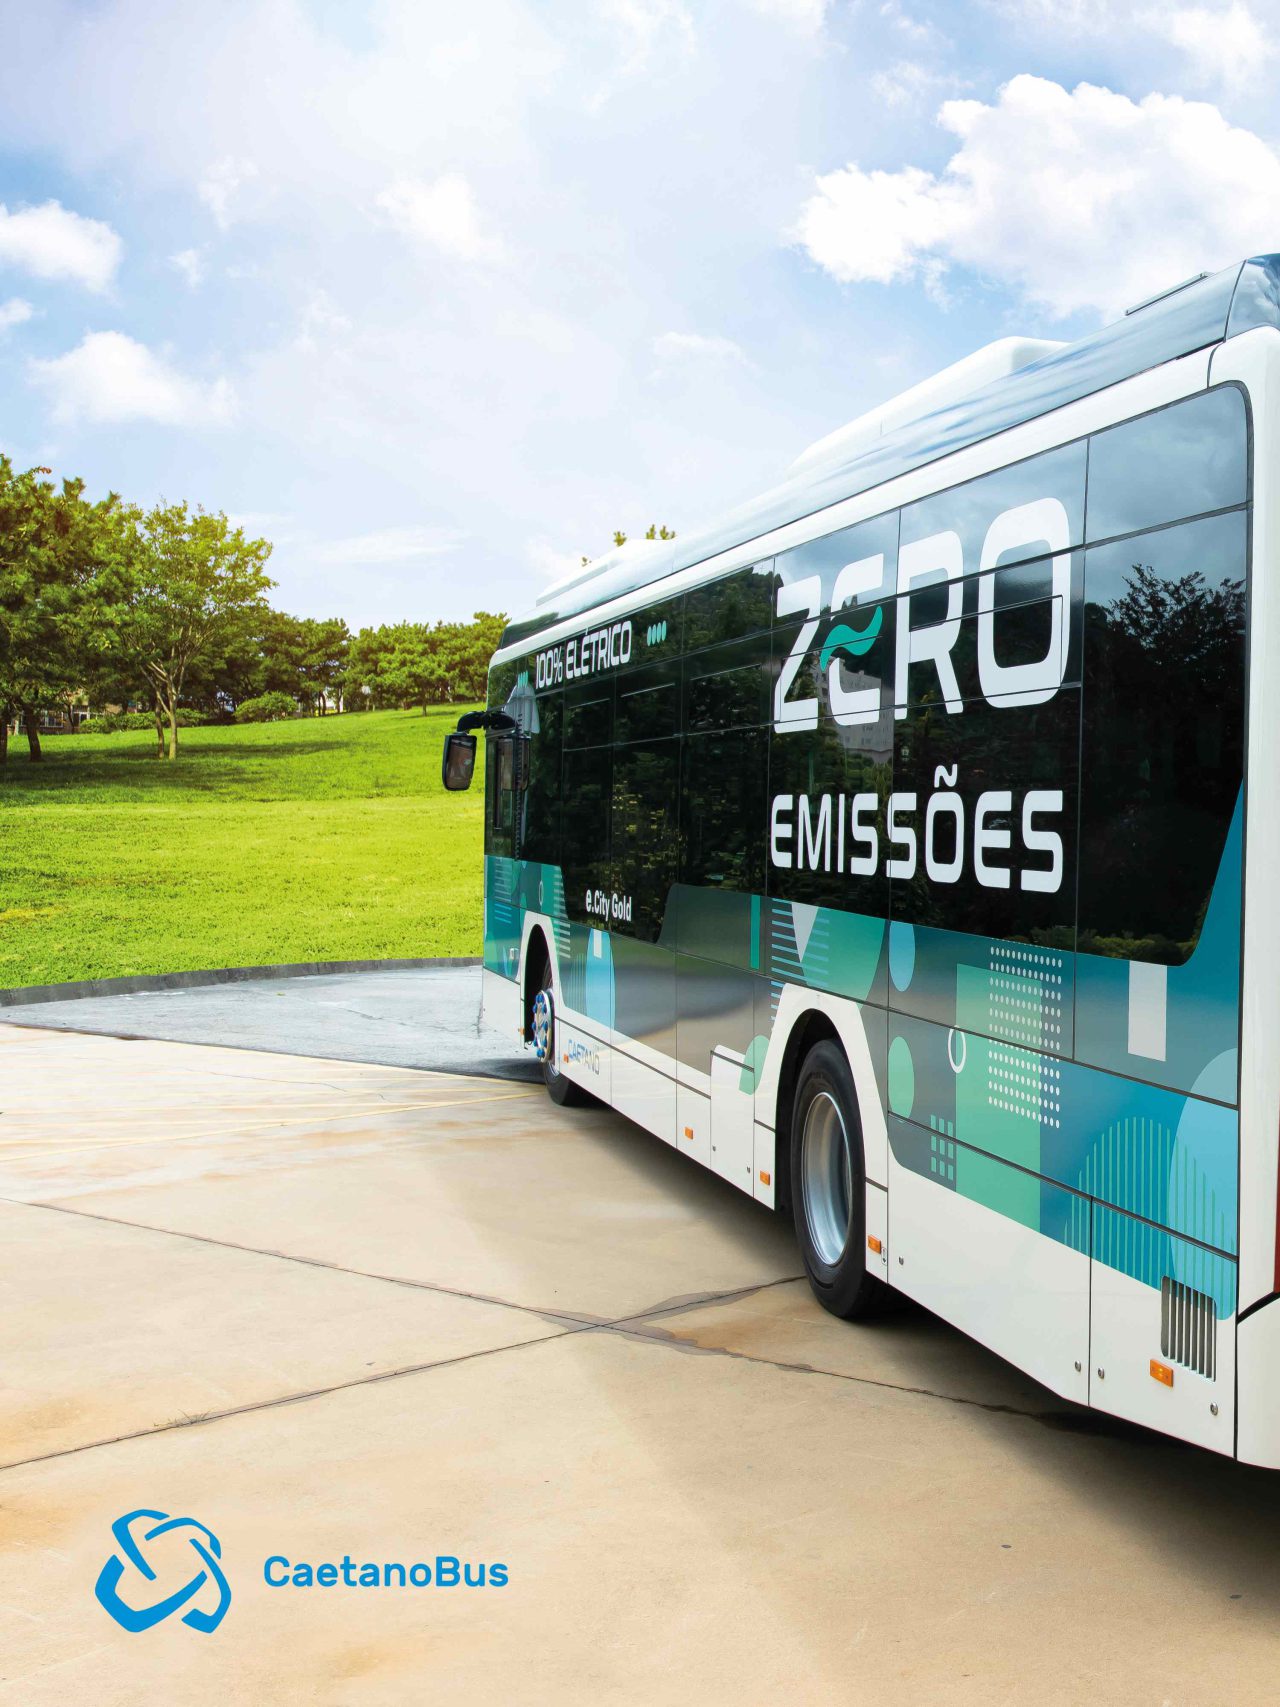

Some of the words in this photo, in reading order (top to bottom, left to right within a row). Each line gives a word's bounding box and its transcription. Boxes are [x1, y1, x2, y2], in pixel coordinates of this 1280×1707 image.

[535, 645, 563, 690] 100%
[565, 627, 632, 680] ELÉTRICO
[773, 497, 1071, 734] ZERO
[770, 763, 1064, 894] EMISSÕES
[585, 889, 611, 922] e.City
[611, 892, 632, 922] Gold
